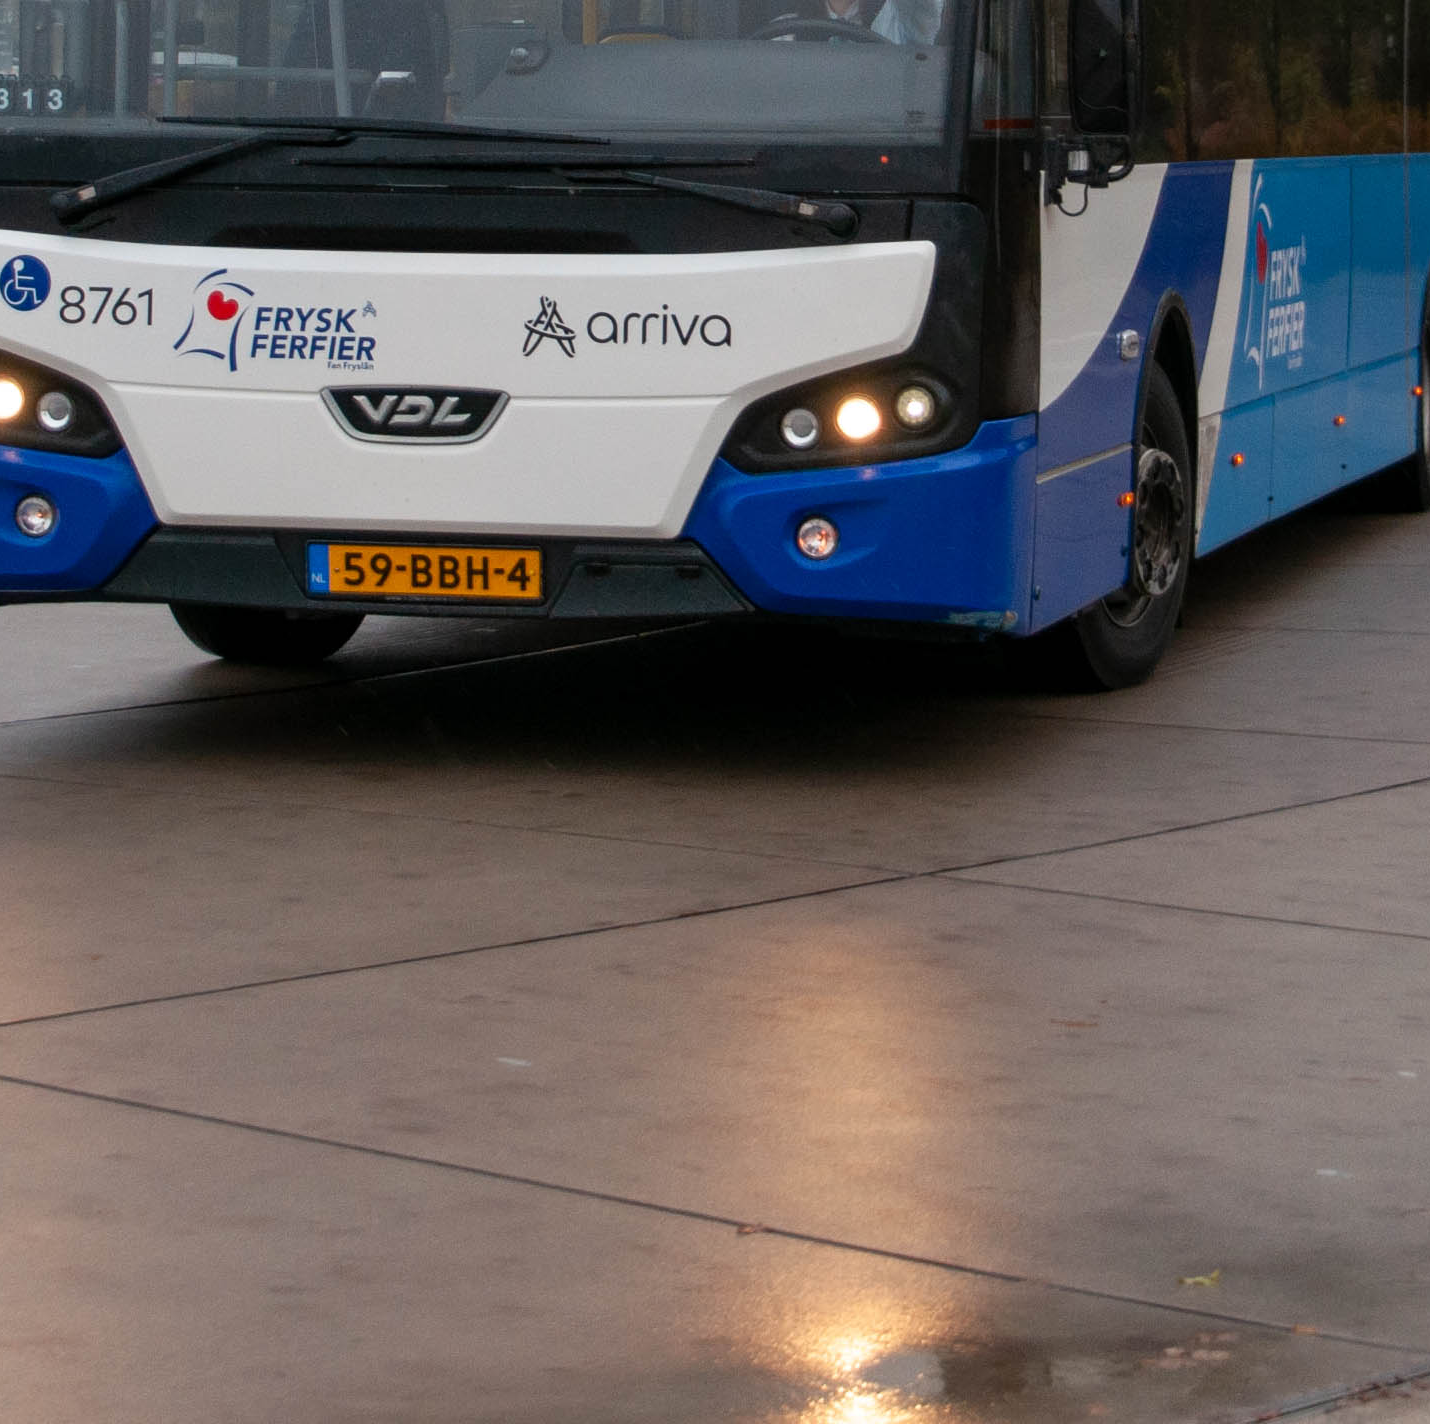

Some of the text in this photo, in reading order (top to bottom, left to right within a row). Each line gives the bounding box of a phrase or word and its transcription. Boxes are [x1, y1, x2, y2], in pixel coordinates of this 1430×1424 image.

[60, 286, 153, 326] 8761
[254, 306, 357, 333] FRYSK
[587, 304, 732, 348] arriva
[250, 334, 377, 361] FERFIER
[353, 394, 471, 427] VDL
[311, 573, 326, 584] NL
[343, 552, 530, 591] 59-BBH-4
